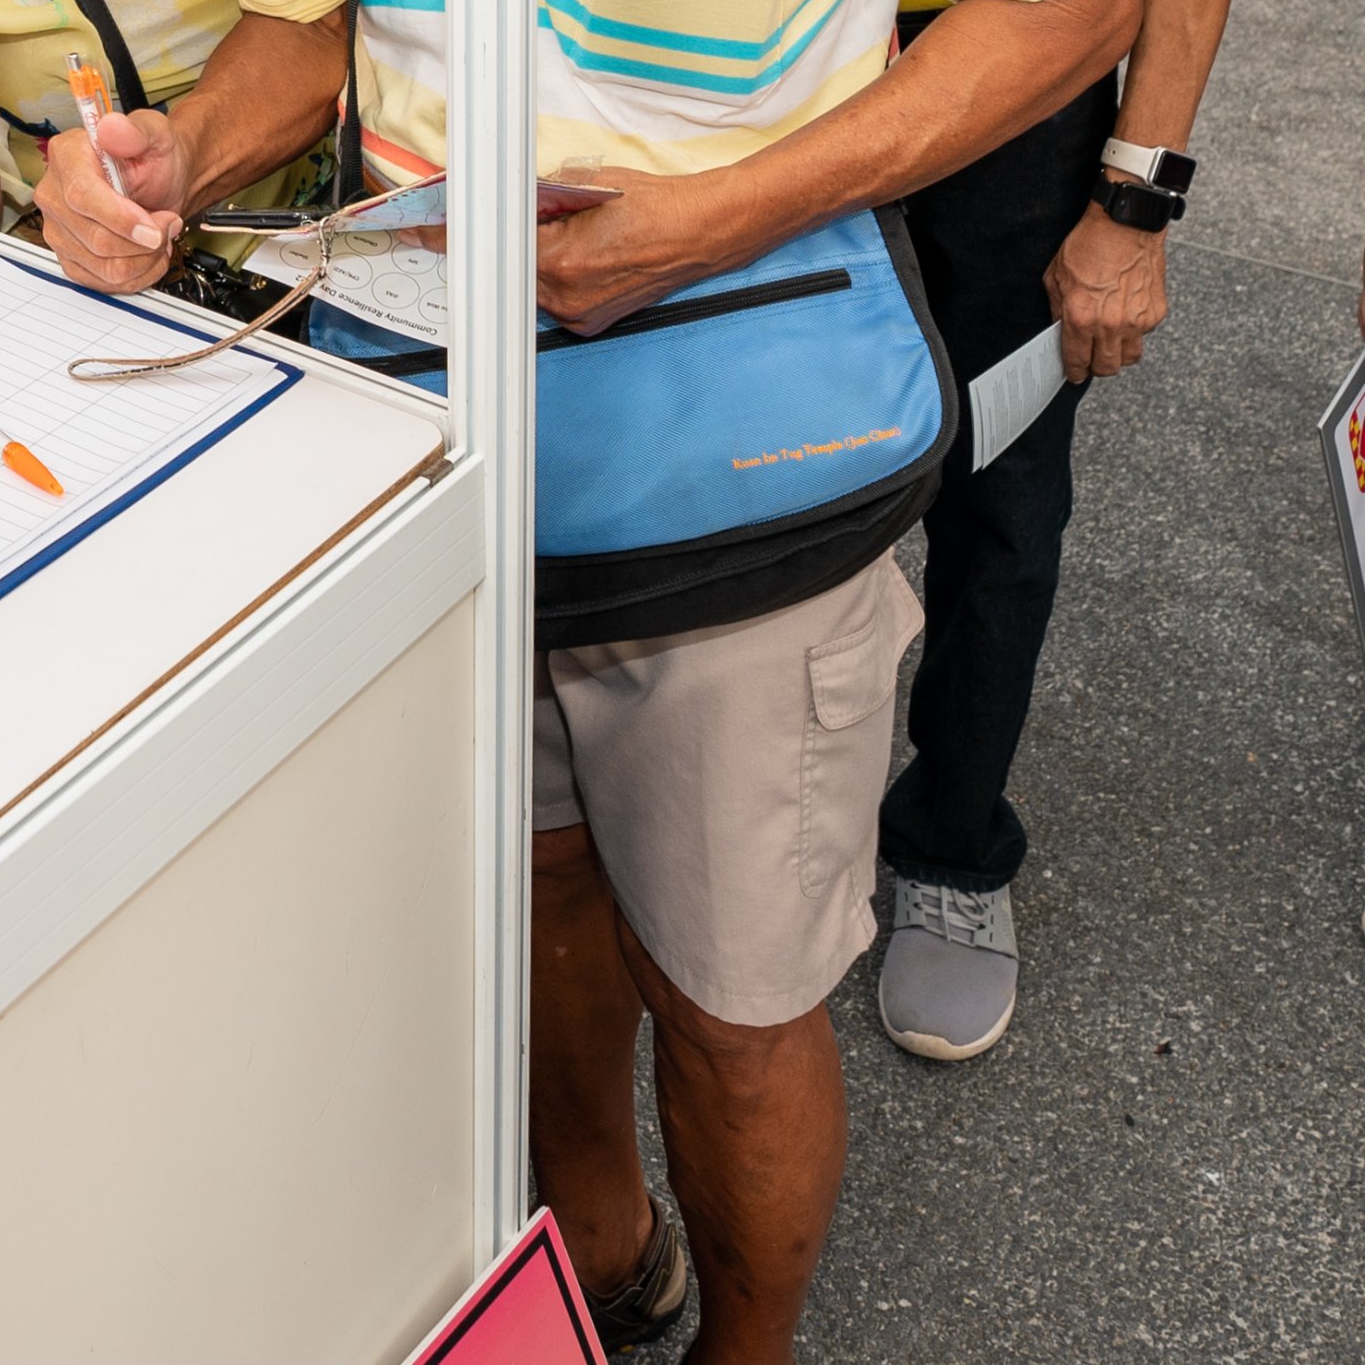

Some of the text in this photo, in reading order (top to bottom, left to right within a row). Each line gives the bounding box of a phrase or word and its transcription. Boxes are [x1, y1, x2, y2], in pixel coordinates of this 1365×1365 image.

[320, 283, 337, 299] Day
[338, 291, 384, 319] Resilience
[384, 313, 438, 336] Community
